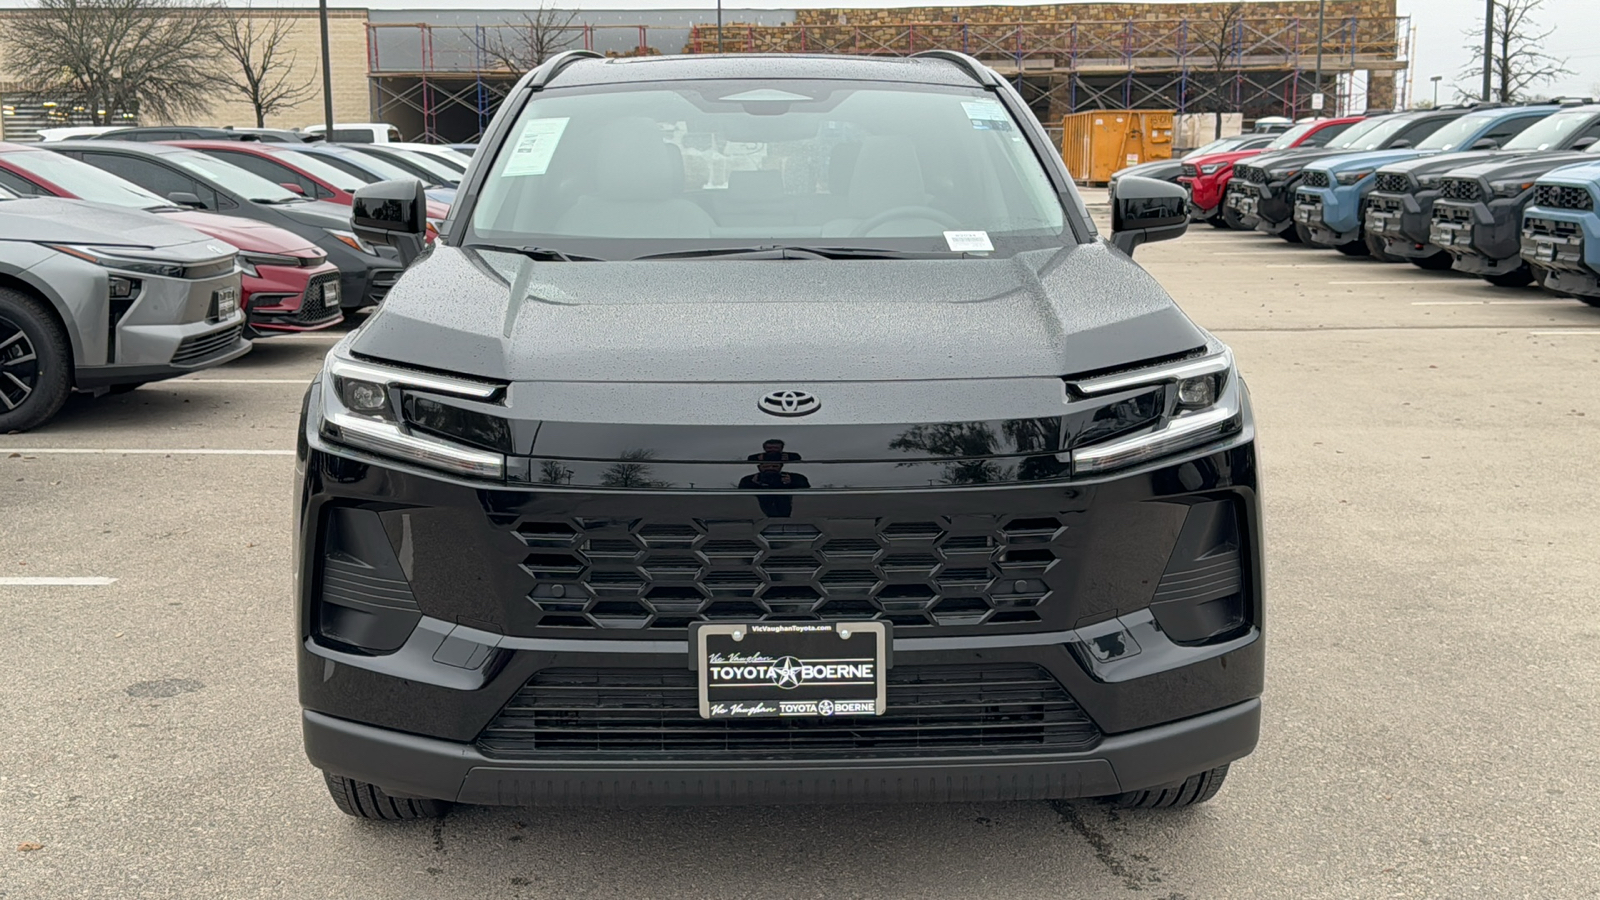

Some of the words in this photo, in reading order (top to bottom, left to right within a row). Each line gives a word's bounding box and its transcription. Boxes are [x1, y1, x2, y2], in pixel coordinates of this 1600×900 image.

[751, 625, 832, 633] VicVaughanToyota.com
[708, 652, 725, 663] Vic
[728, 652, 773, 664] Vaughan
[710, 666, 778, 680] TOYOTA
[801, 664, 874, 679] BOERNE
[710, 703, 728, 716] Vic
[730, 702, 777, 716] Vaughan
[780, 704, 817, 713] TOYOTA
[834, 703, 875, 712] BOERNE
